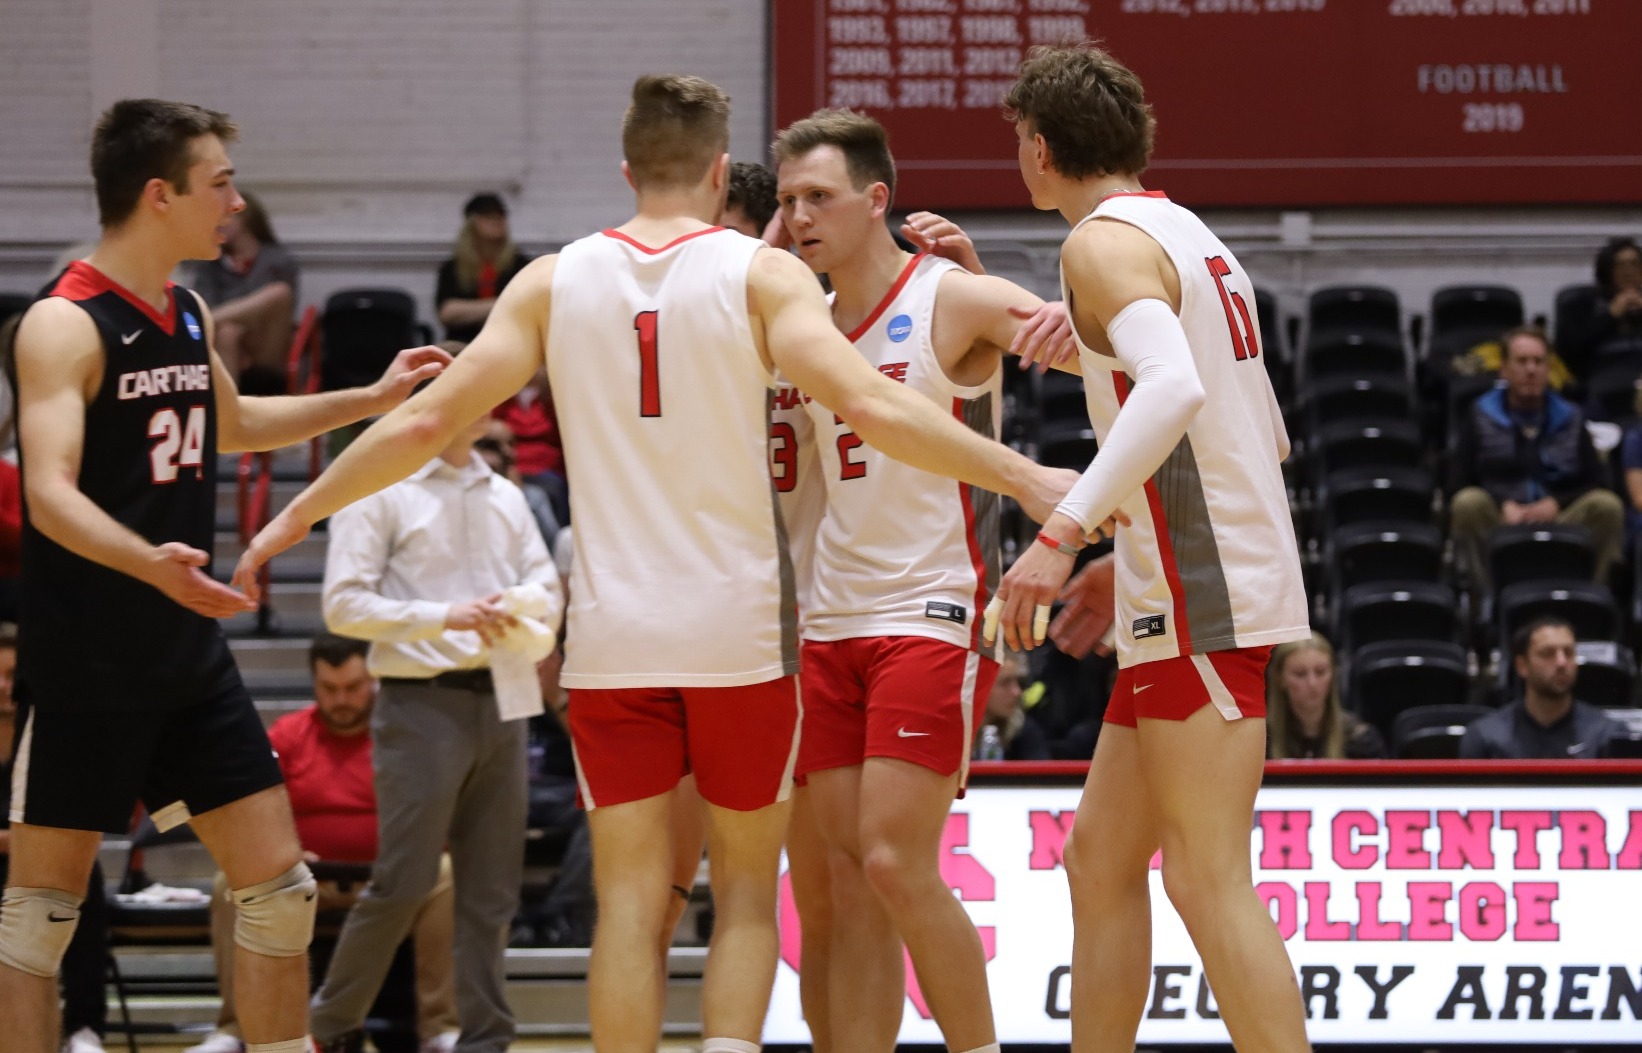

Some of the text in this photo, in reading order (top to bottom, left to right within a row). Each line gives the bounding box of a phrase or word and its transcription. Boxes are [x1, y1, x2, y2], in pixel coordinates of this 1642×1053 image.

[1417, 64, 1568, 95] FOOTBALL
[1204, 255, 1259, 361] 15
[633, 309, 662, 418] 1
[147, 405, 206, 484] 24
[954, 609, 961, 617] L
[1150, 621, 1161, 630] XL
[1252, 881, 1560, 941] OLLEGE
